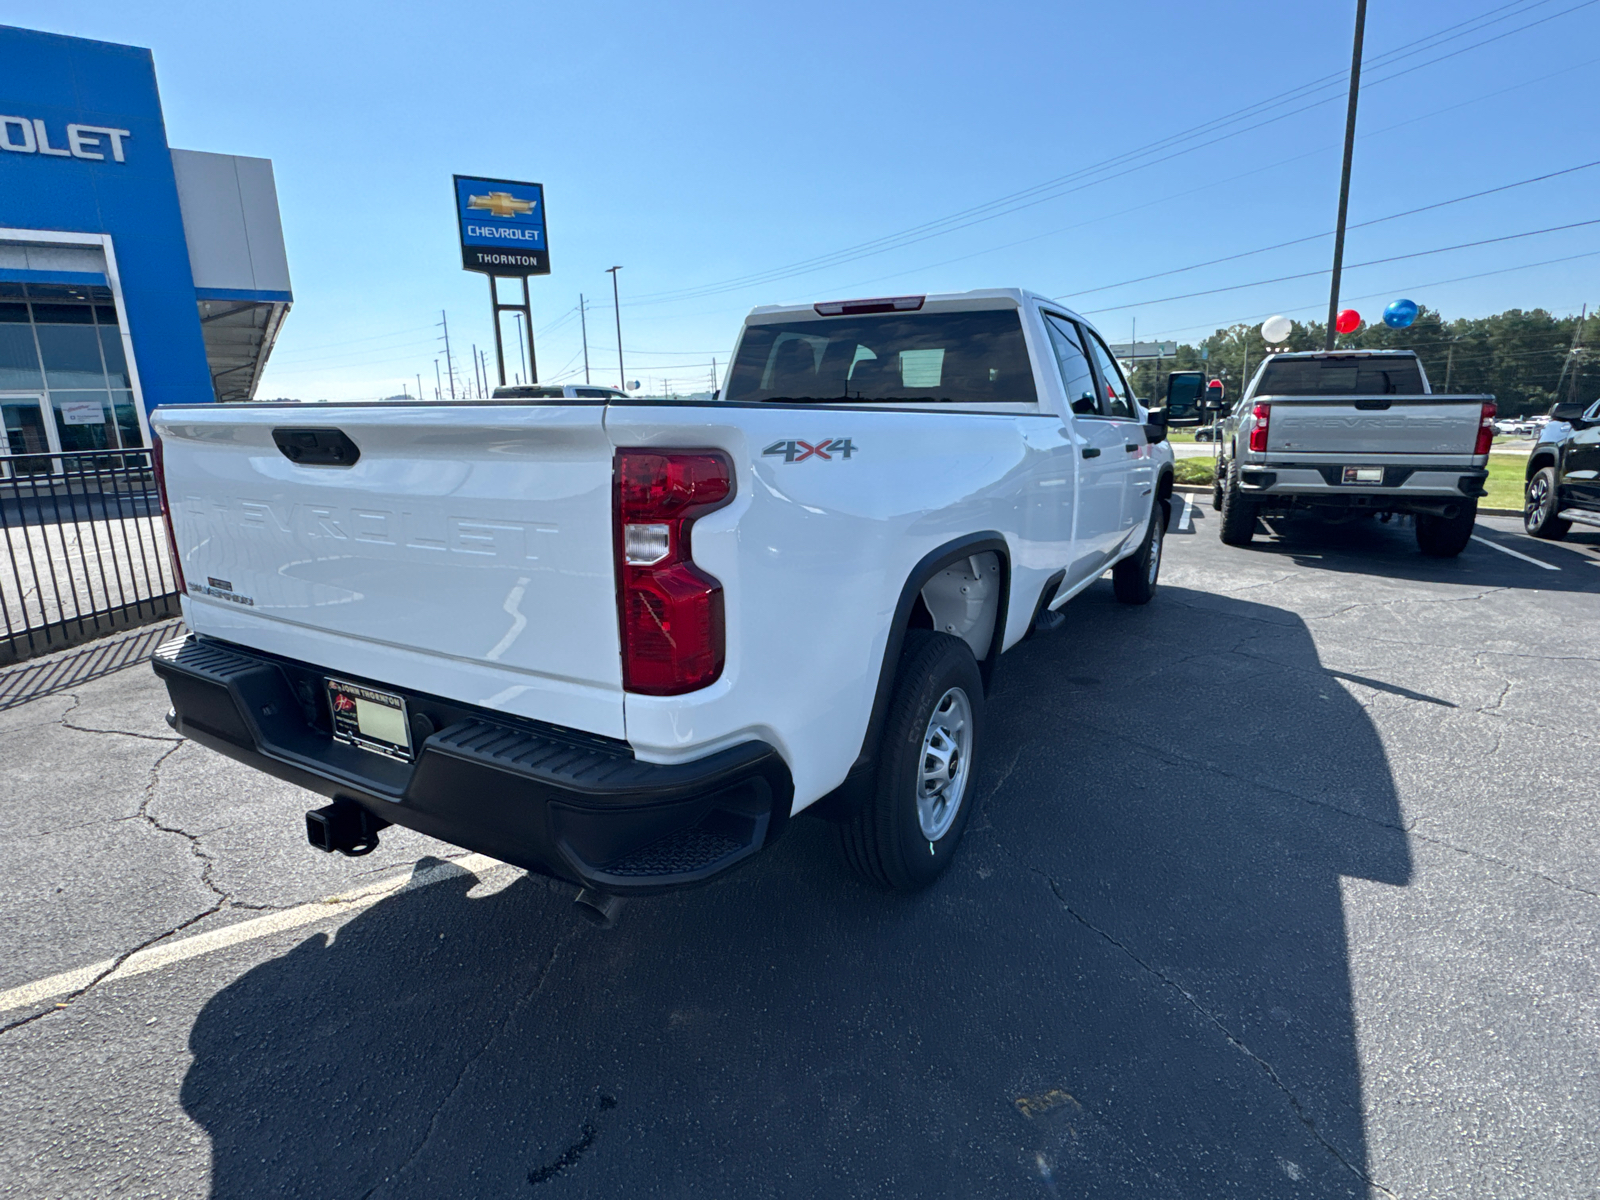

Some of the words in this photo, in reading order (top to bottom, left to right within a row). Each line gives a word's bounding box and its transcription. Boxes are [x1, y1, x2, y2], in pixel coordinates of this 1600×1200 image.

[468, 225, 539, 241] CHEVROLET
[477, 253, 537, 266] THORNTON
[341, 684, 360, 695] JOHN
